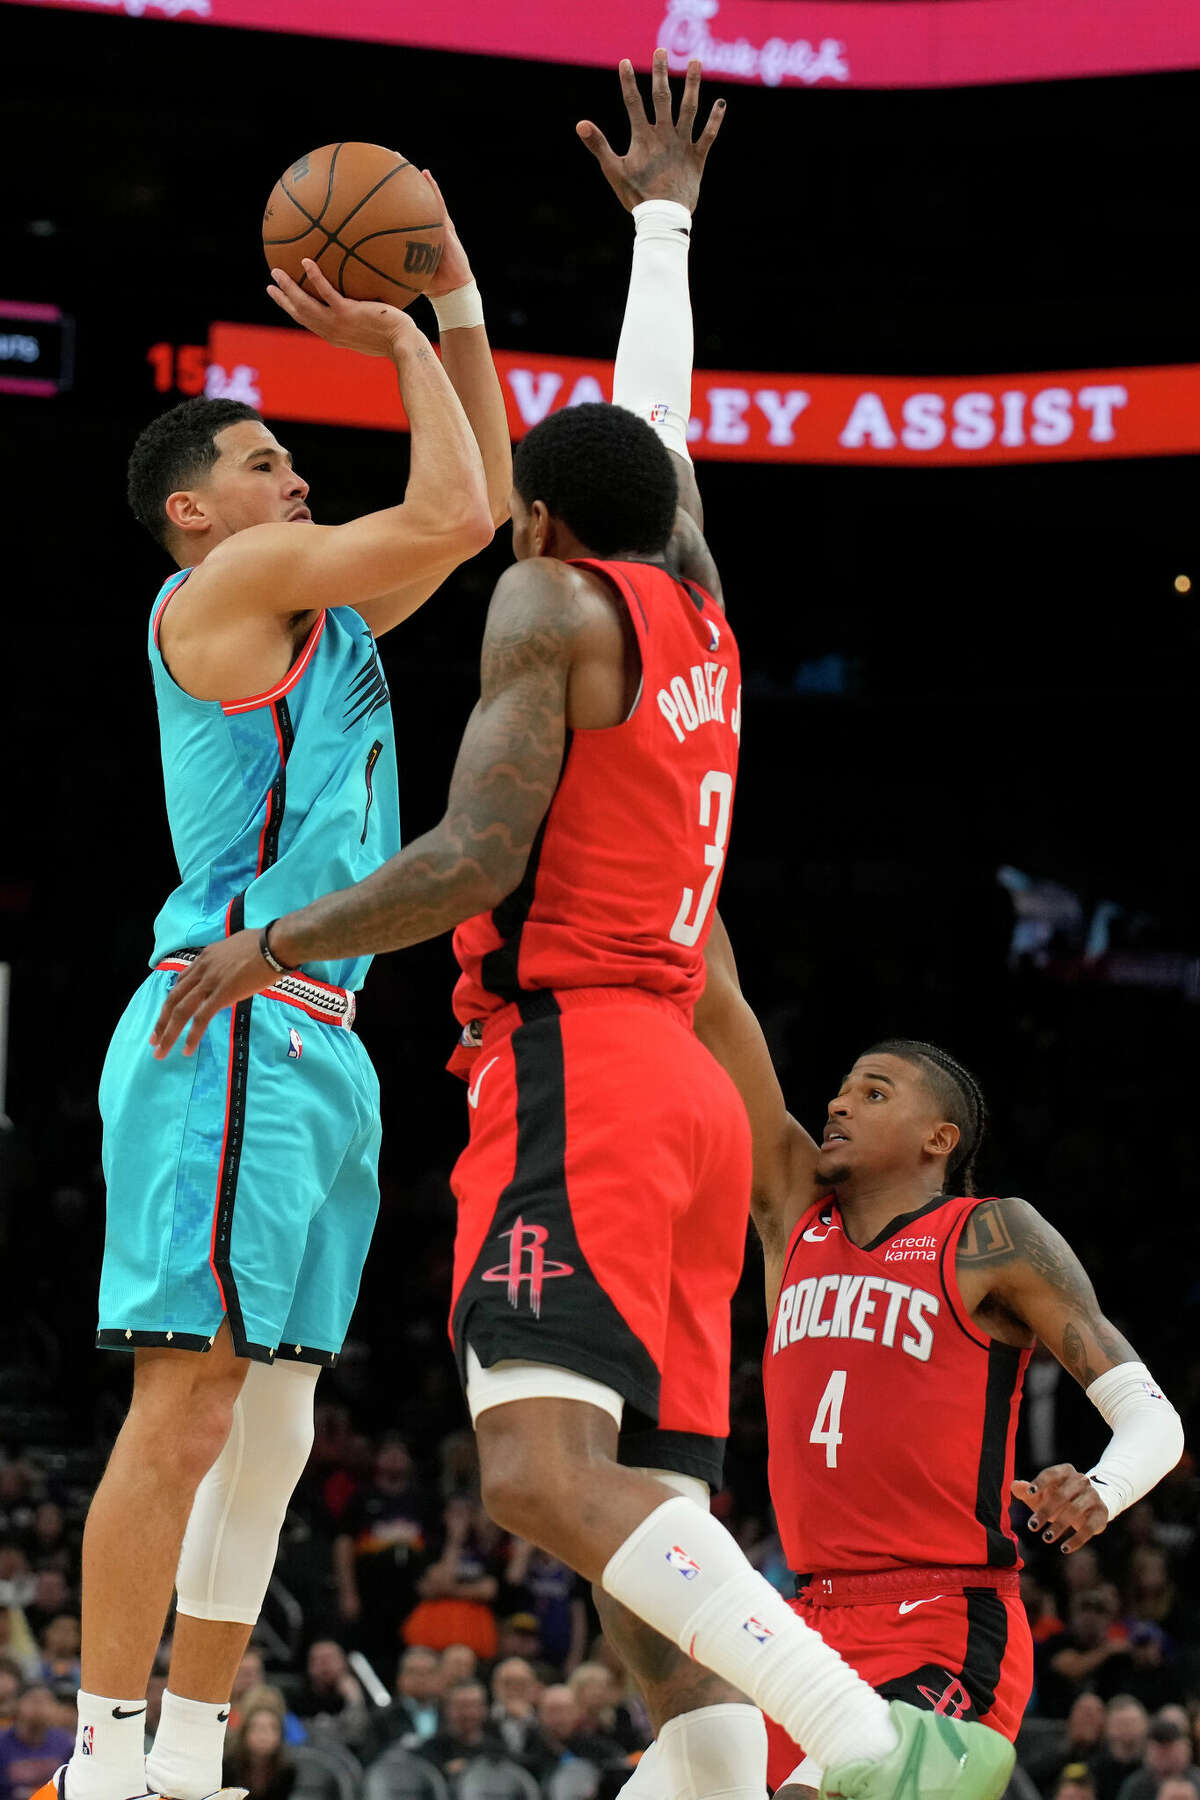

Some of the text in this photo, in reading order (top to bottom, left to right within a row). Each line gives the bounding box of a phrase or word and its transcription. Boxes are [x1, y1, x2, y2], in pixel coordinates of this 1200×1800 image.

[508, 369, 1127, 450] VAEY ASSIST
[669, 770, 732, 946] 3
[885, 1250, 936, 1262] karma
[892, 1236, 937, 1249] credit
[772, 1274, 940, 1362] ROCKETS
[809, 1370, 847, 1468] 4
